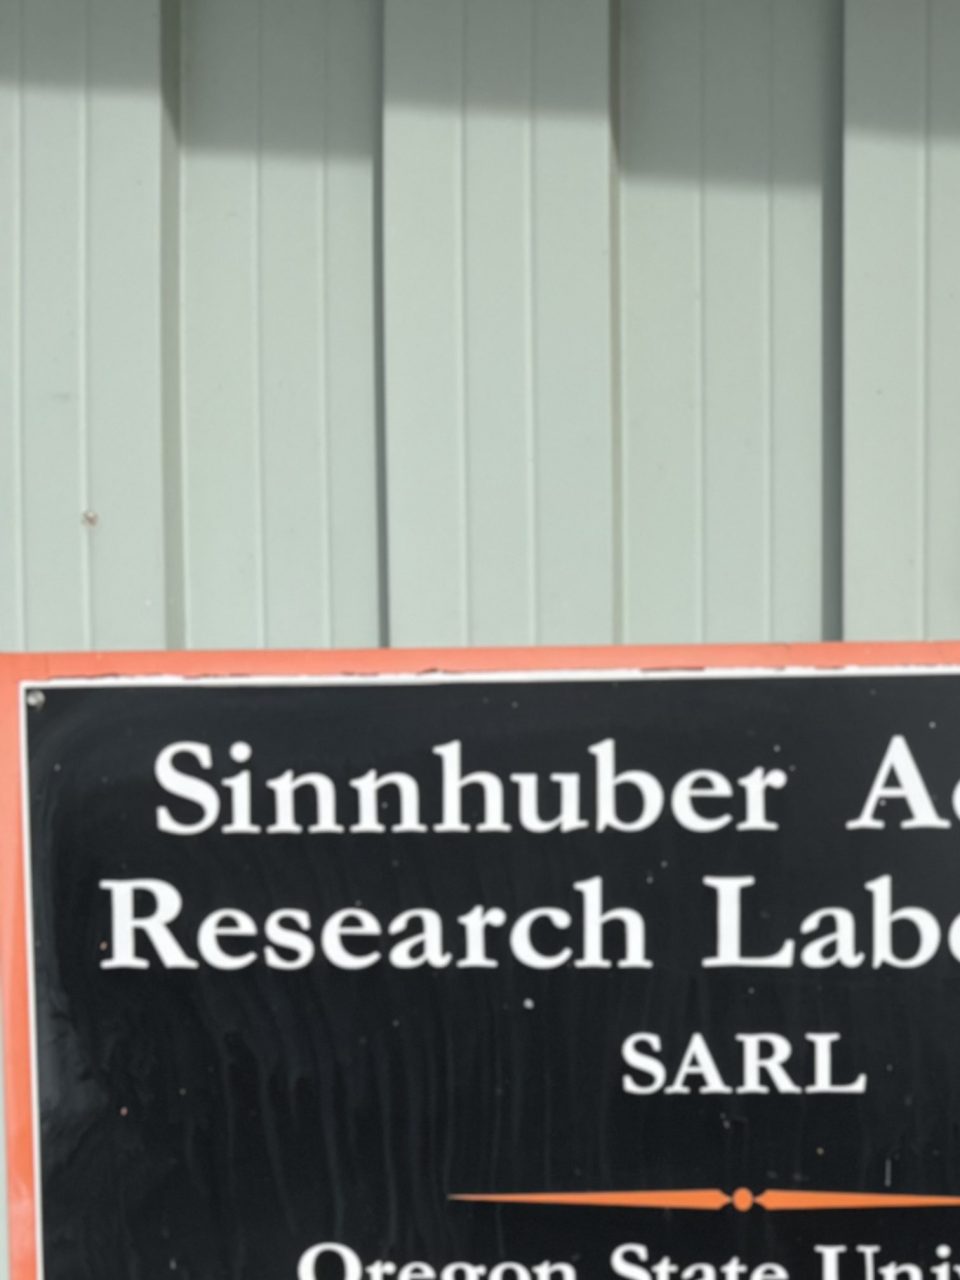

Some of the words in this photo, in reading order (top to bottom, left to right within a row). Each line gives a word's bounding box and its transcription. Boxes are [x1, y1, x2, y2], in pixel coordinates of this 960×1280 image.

[154, 738, 788, 836] Sinnhuber
[99, 875, 653, 970] Research
[621, 1032, 867, 1095] SARL
